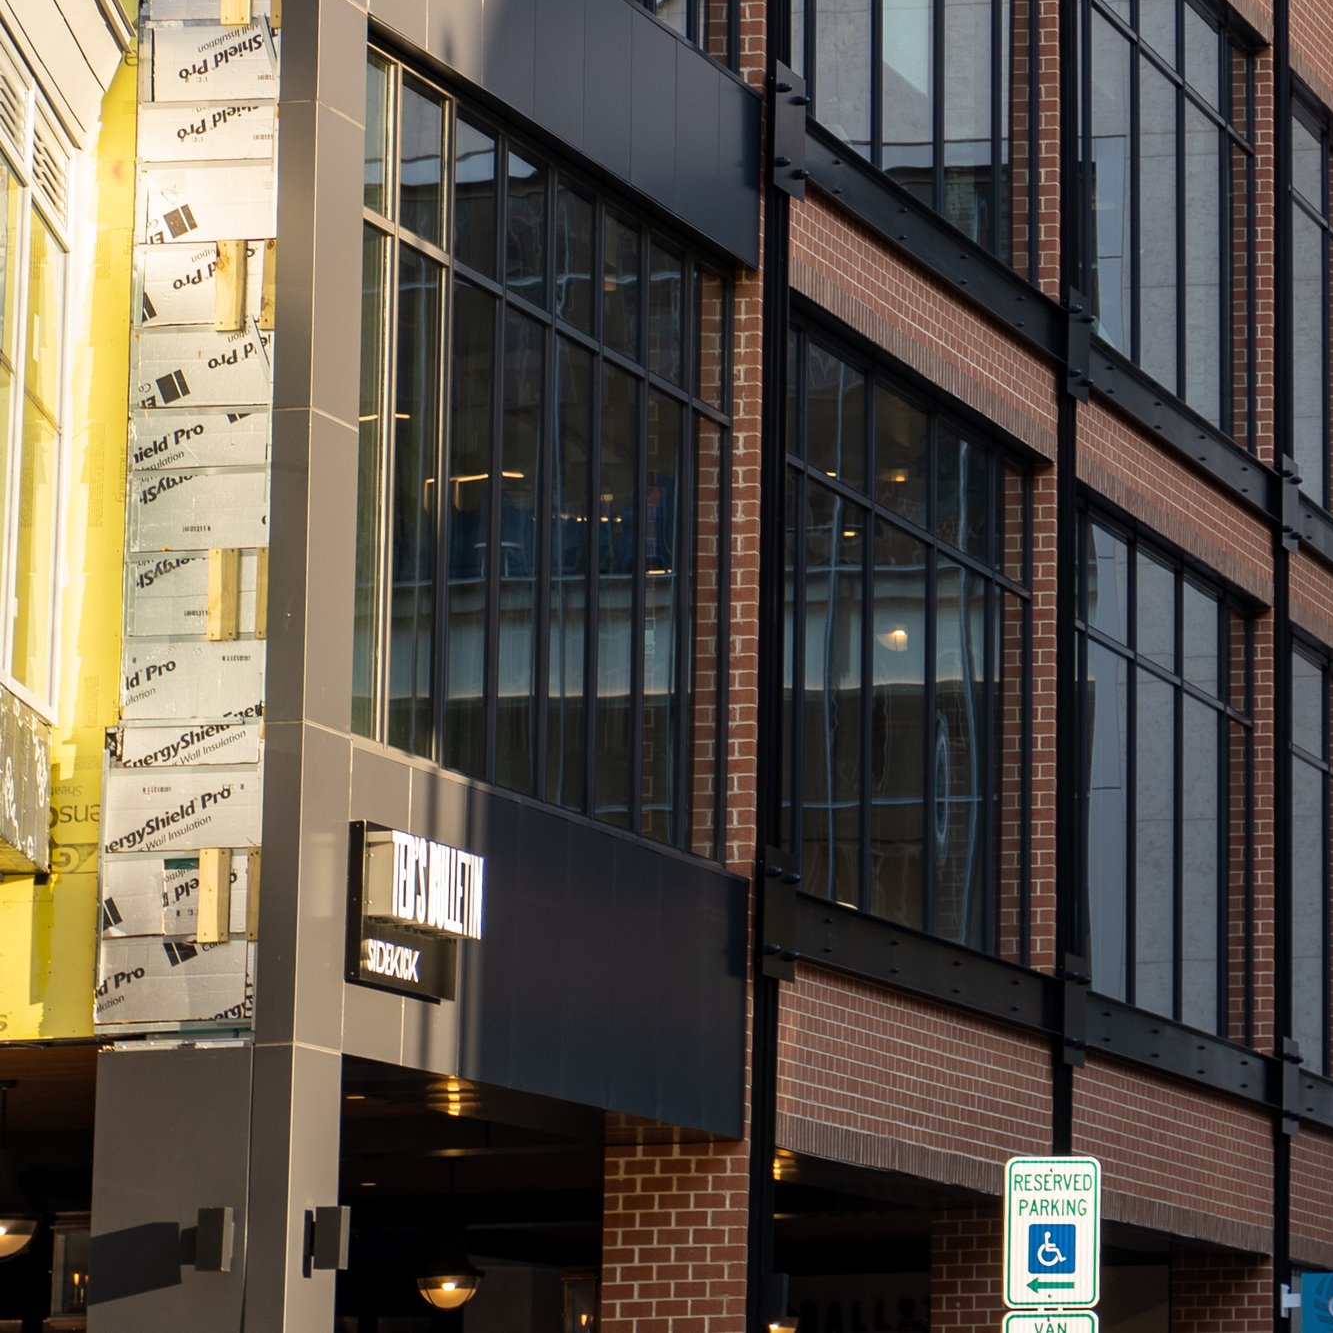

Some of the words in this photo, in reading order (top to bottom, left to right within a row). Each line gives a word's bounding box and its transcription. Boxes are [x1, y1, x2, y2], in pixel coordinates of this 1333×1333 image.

[178, 58, 209, 81] Pro
[176, 118, 207, 140] Pro
[172, 269, 202, 290] Pro
[207, 349, 239, 369] Pro
[173, 424, 204, 446] Pro
[145, 660, 177, 682] Pro
[203, 729, 247, 755] Insulation
[201, 788, 232, 810] Pro
[168, 815, 212, 838] Insulation
[427, 840, 484, 941] BULLETIN
[366, 938, 421, 984] SIDEKICK
[113, 967, 145, 989] Pro
[1013, 1173, 1093, 1192] RESERVED
[1018, 1199, 1088, 1217] PARKING
[1034, 1322, 1068, 1333] VAN
